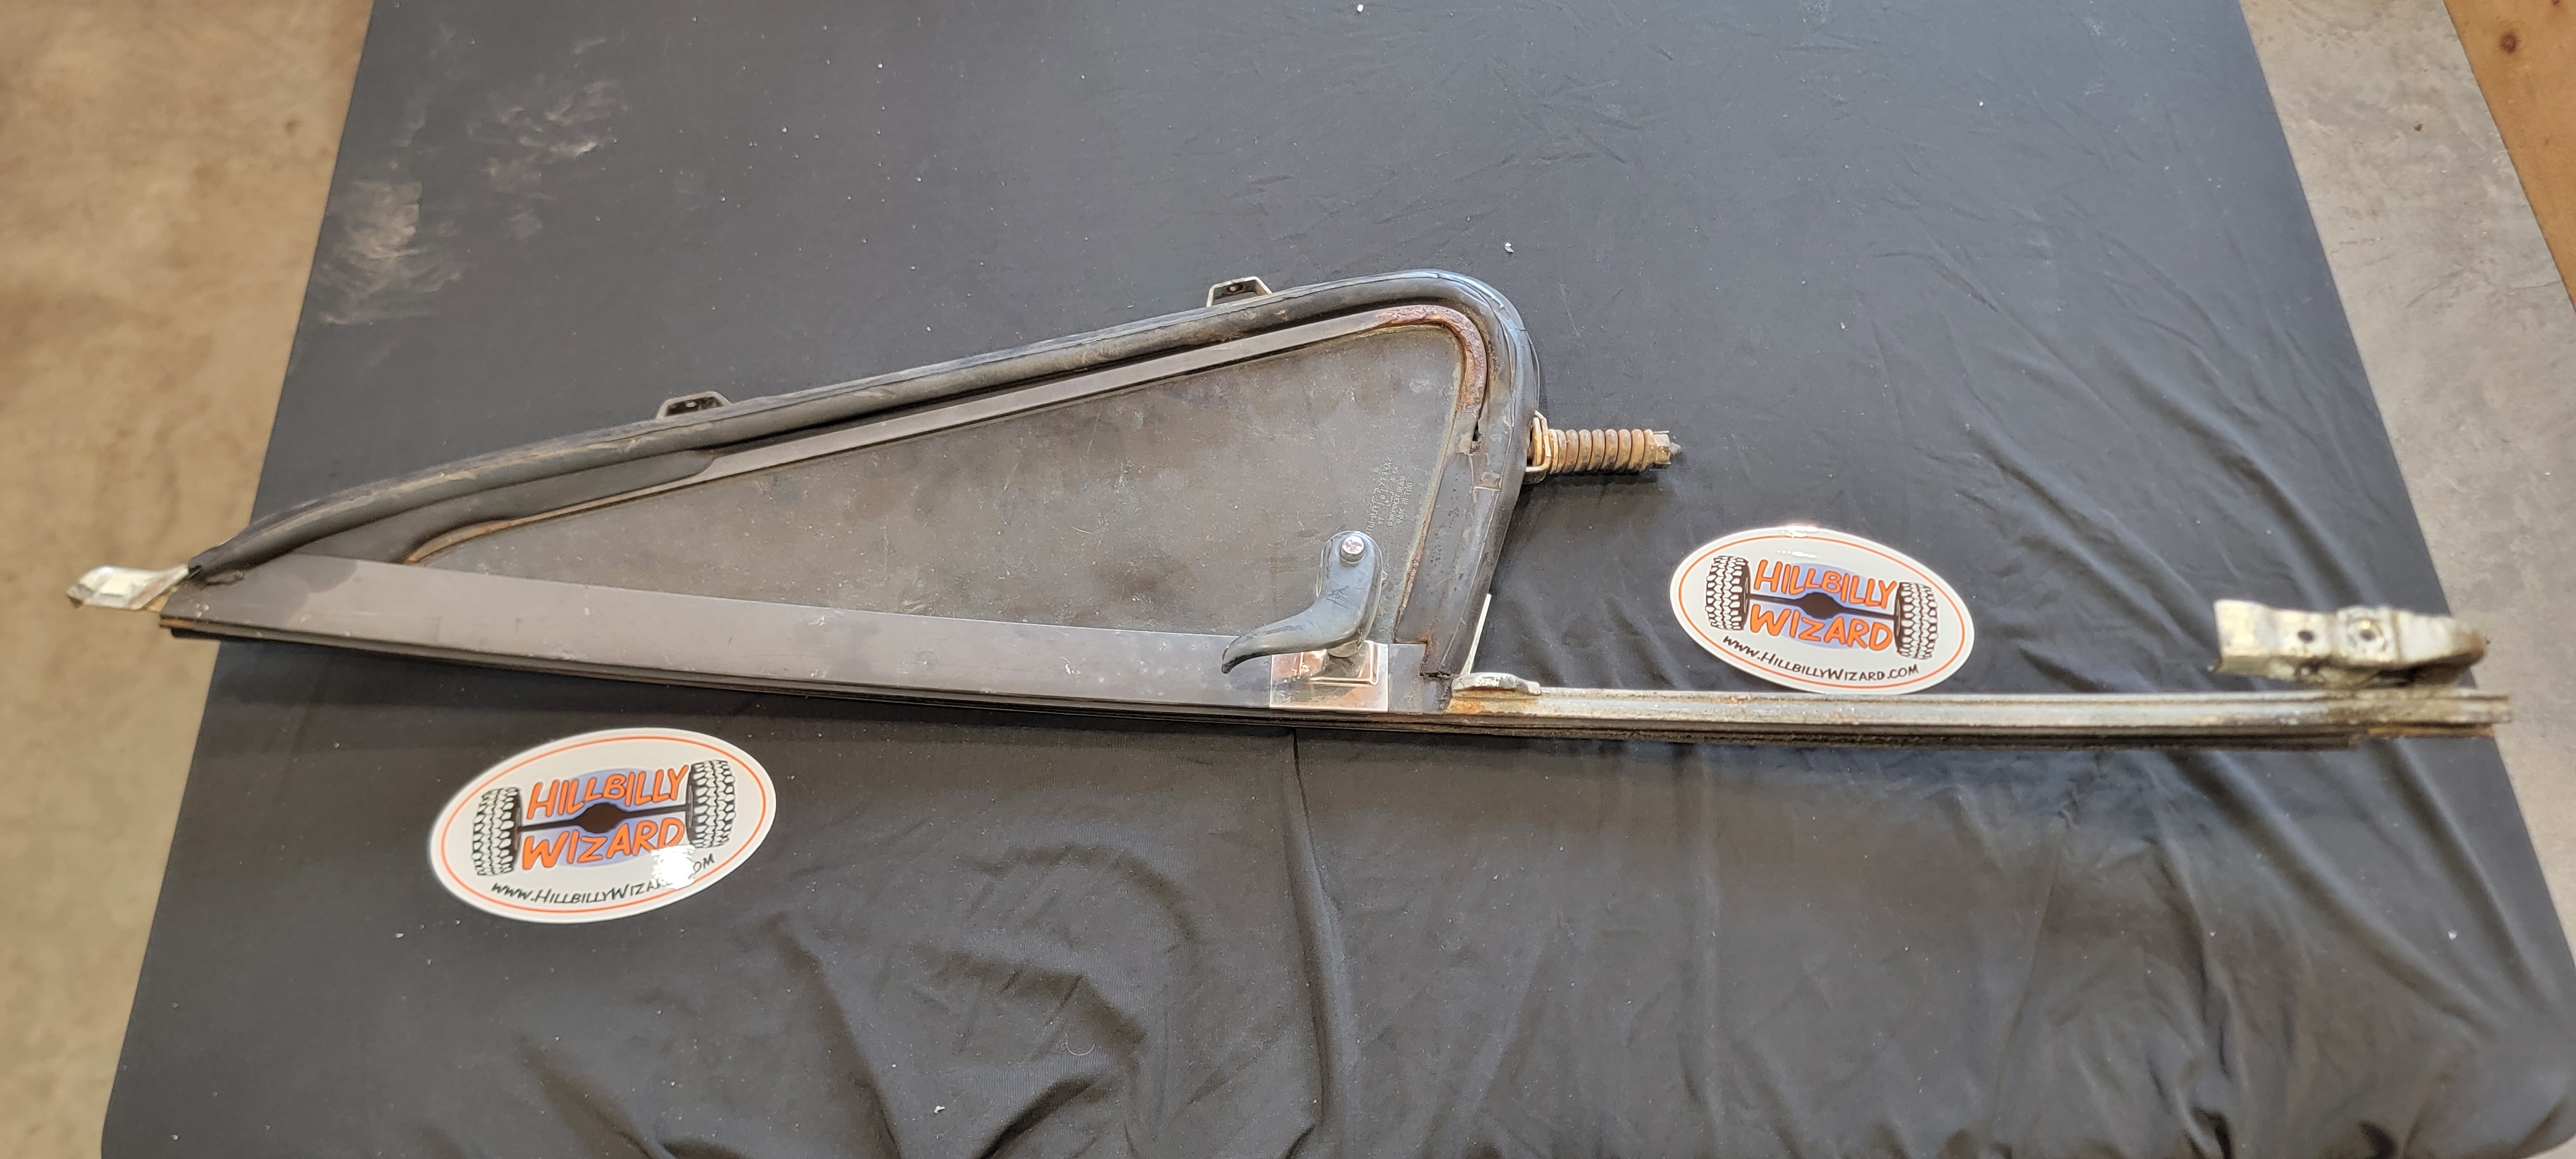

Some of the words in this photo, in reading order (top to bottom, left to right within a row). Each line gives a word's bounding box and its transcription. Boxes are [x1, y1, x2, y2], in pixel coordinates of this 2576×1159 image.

[1754, 560, 1897, 608] HILLBILLY
[1750, 604, 1893, 651] WIZARD
[526, 765, 689, 820] HILLBILLY
[522, 818, 685, 870] WIZARD
